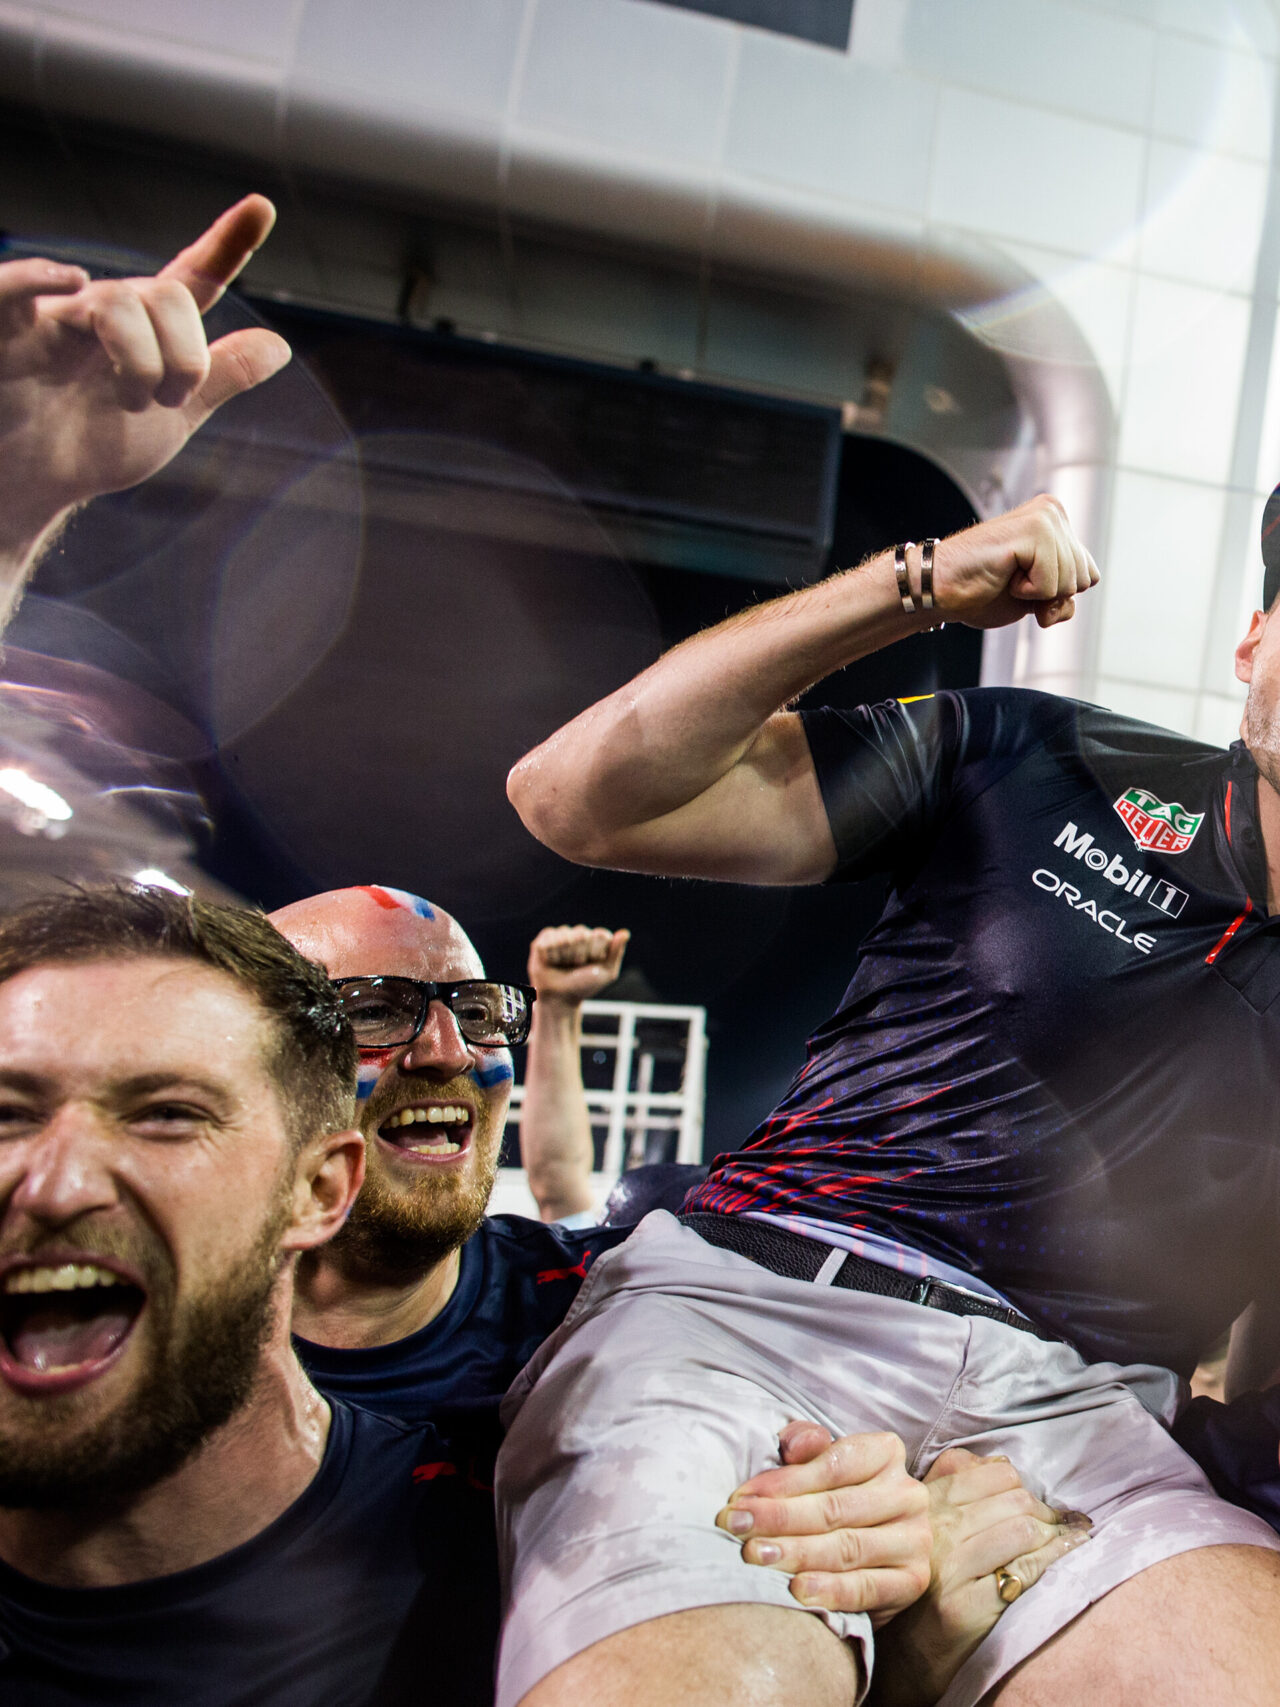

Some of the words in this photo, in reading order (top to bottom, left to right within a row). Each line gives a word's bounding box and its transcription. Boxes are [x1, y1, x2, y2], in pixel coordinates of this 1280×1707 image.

[1119, 801, 1188, 850] HEUER
[1135, 790, 1196, 834] TAG
[1053, 821, 1153, 898] Mobil
[1031, 868, 1158, 955] ORACLE
